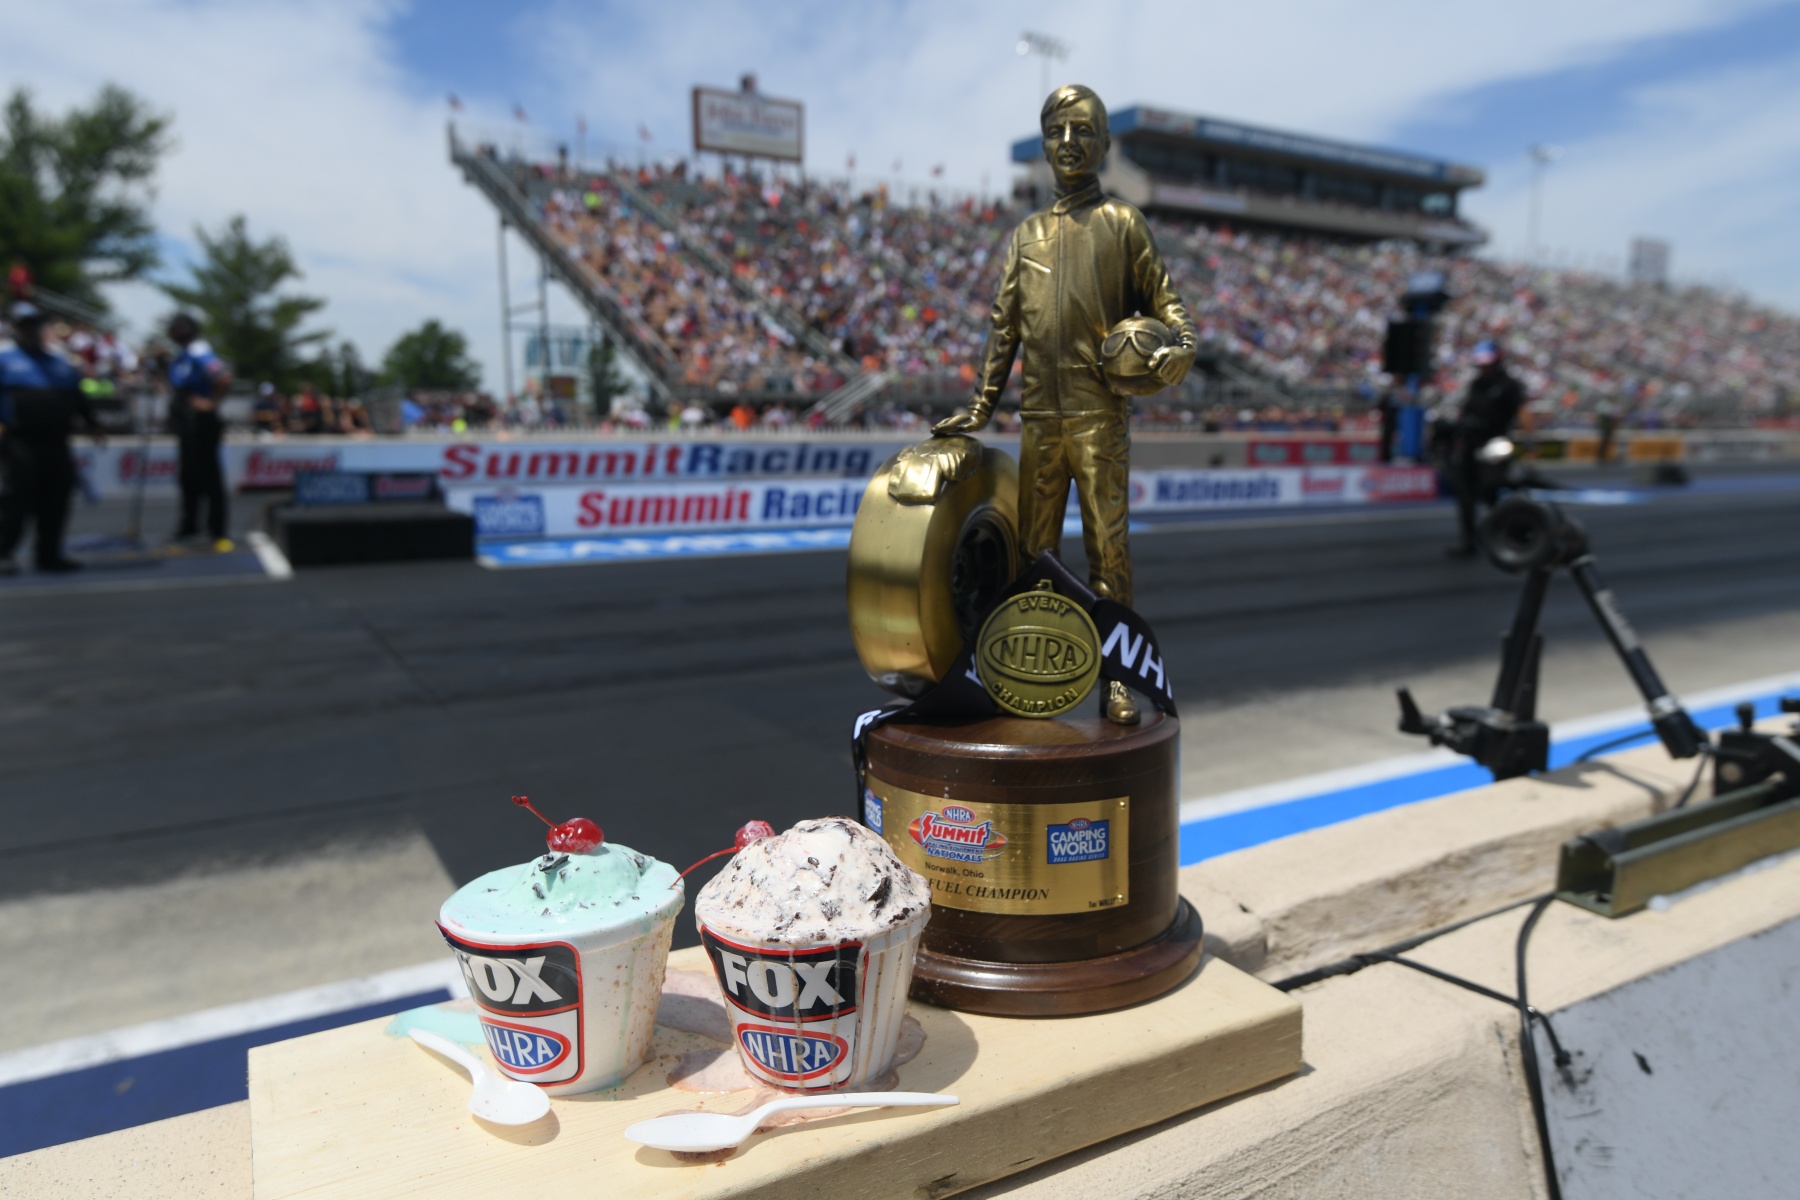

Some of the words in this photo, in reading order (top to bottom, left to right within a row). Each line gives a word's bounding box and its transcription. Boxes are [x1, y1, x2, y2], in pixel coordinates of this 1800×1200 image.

[577, 486, 751, 528] Summit
[1018, 597, 1070, 616] EVENT
[1000, 636, 1077, 673] NHRA
[1101, 621, 1172, 699] NH
[992, 682, 1078, 712] CHAMPION
[945, 808, 972, 821] NHRA
[1050, 828, 1106, 844] CAMPING
[1051, 839, 1106, 856] WORLD
[927, 847, 983, 862] NATIONALS
[925, 861, 960, 875] Norwalk,
[962, 868, 985, 879] Ohio
[928, 878, 962, 895] FUEL
[966, 884, 1050, 900] CHAMPION
[716, 947, 846, 1010] FOX
[482, 1023, 555, 1066] NHRA
[747, 1032, 832, 1072] NHRA
